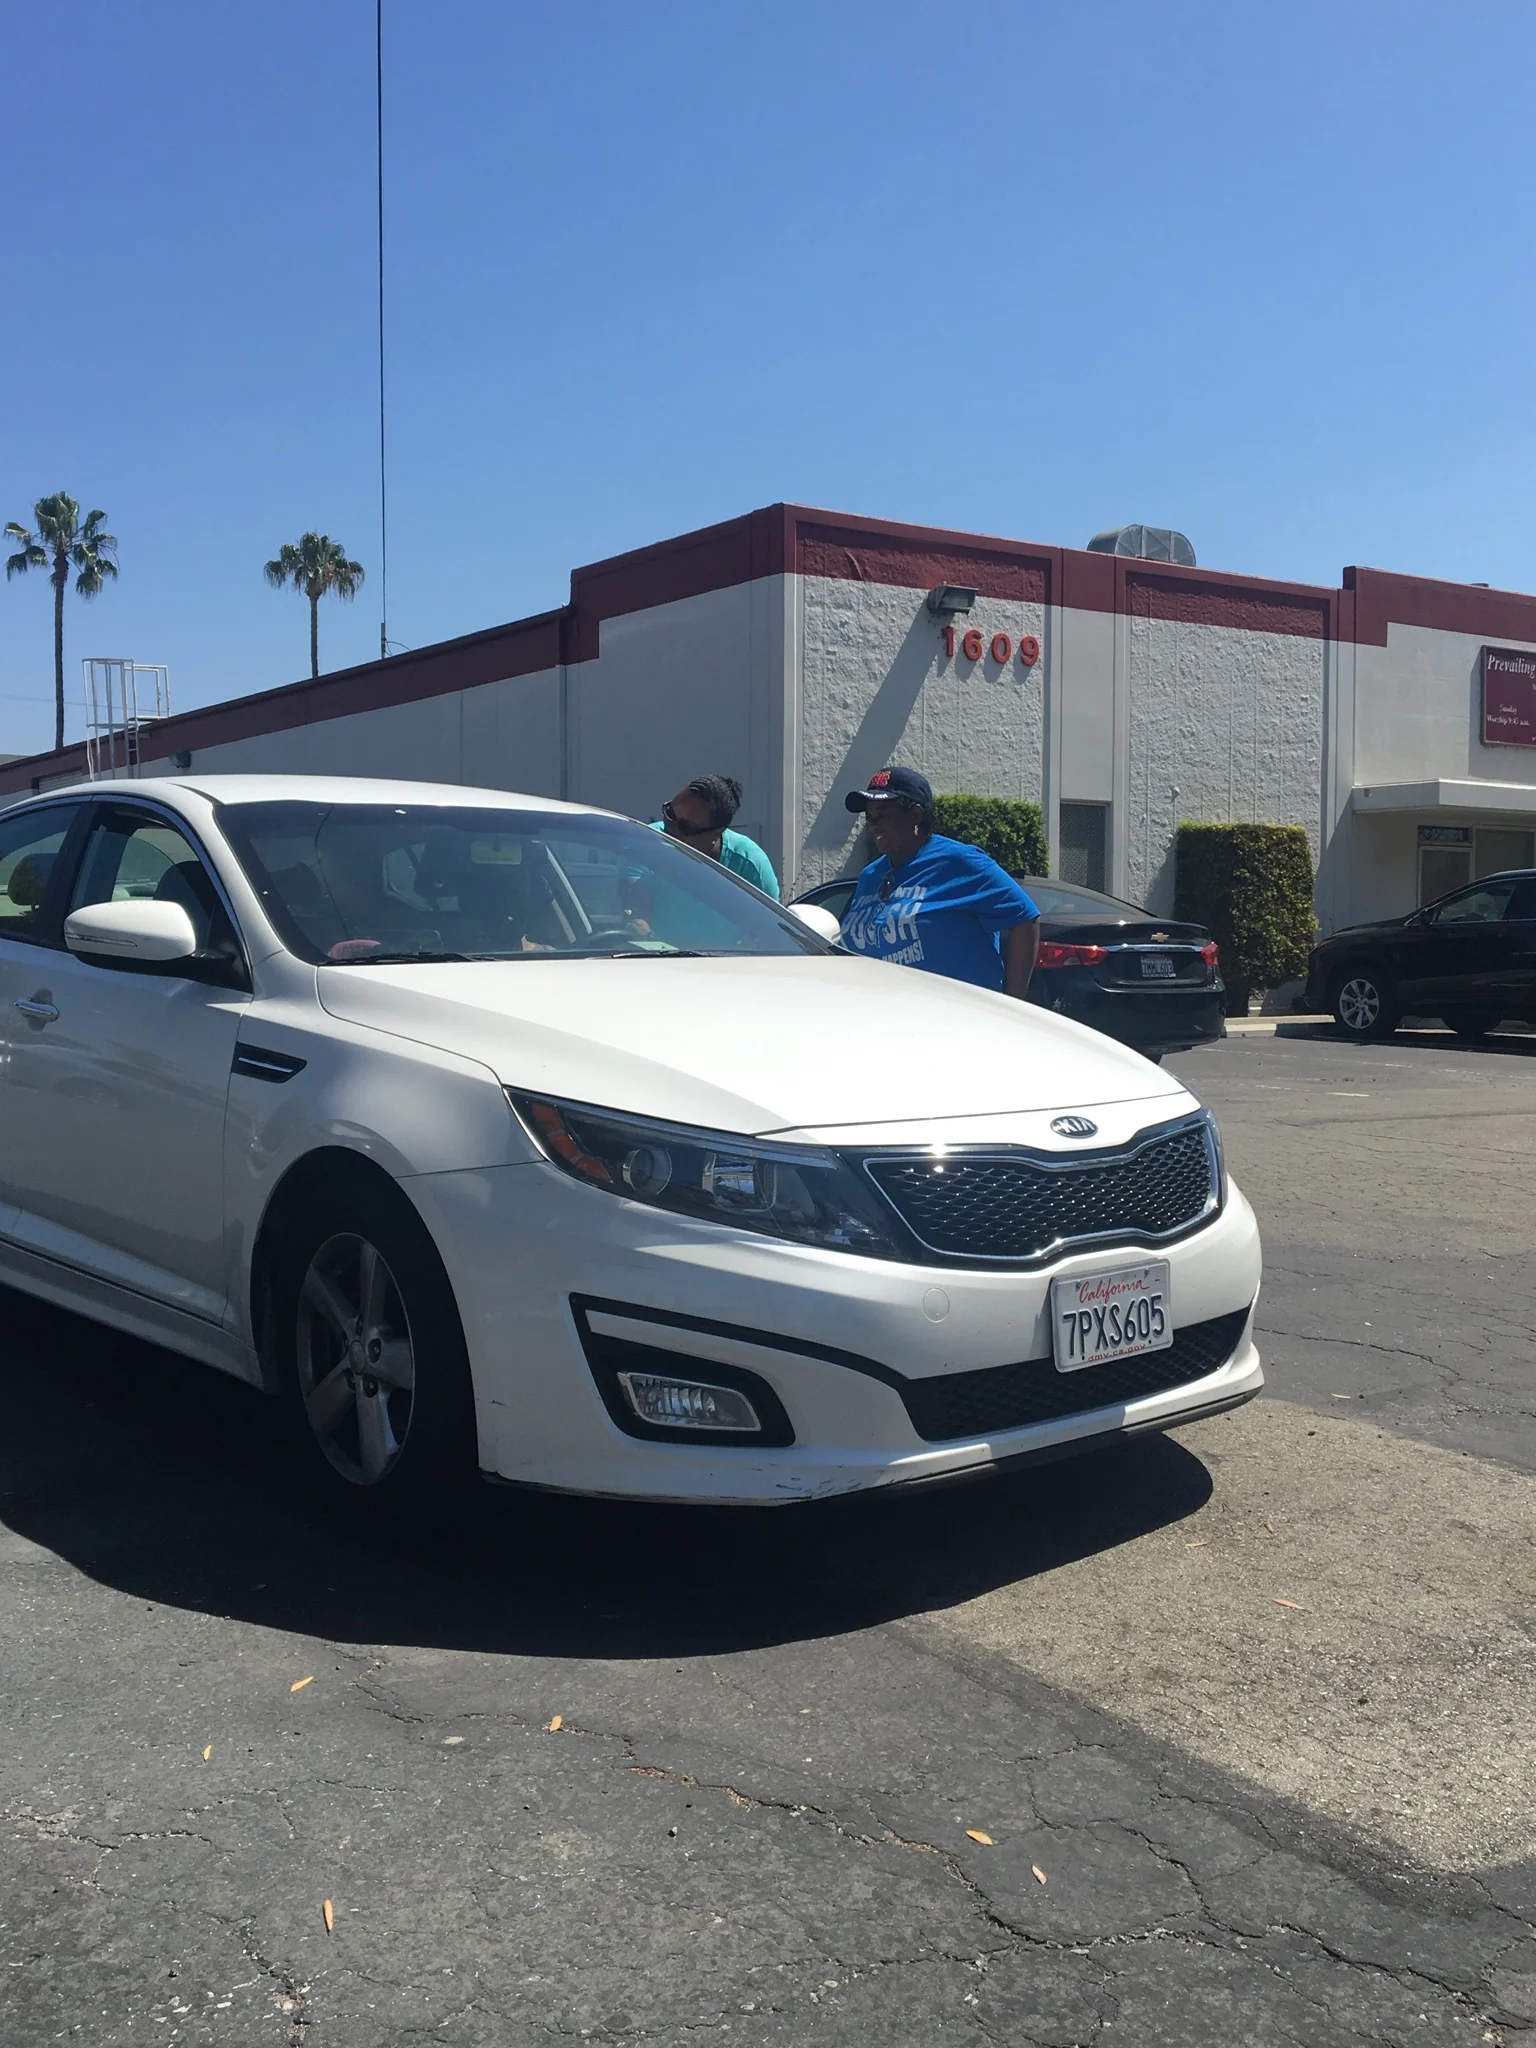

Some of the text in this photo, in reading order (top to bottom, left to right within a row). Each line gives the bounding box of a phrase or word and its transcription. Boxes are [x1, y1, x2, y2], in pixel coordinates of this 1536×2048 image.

[943, 626, 1040, 667] 1609
[1487, 654, 1536, 679] Prevailing
[1053, 1117, 1095, 1133] KIA
[1078, 1277, 1149, 1304] California
[1062, 1294, 1165, 1358] 7PXS605
[1087, 1344, 1146, 1363] dmv.ca.gov
